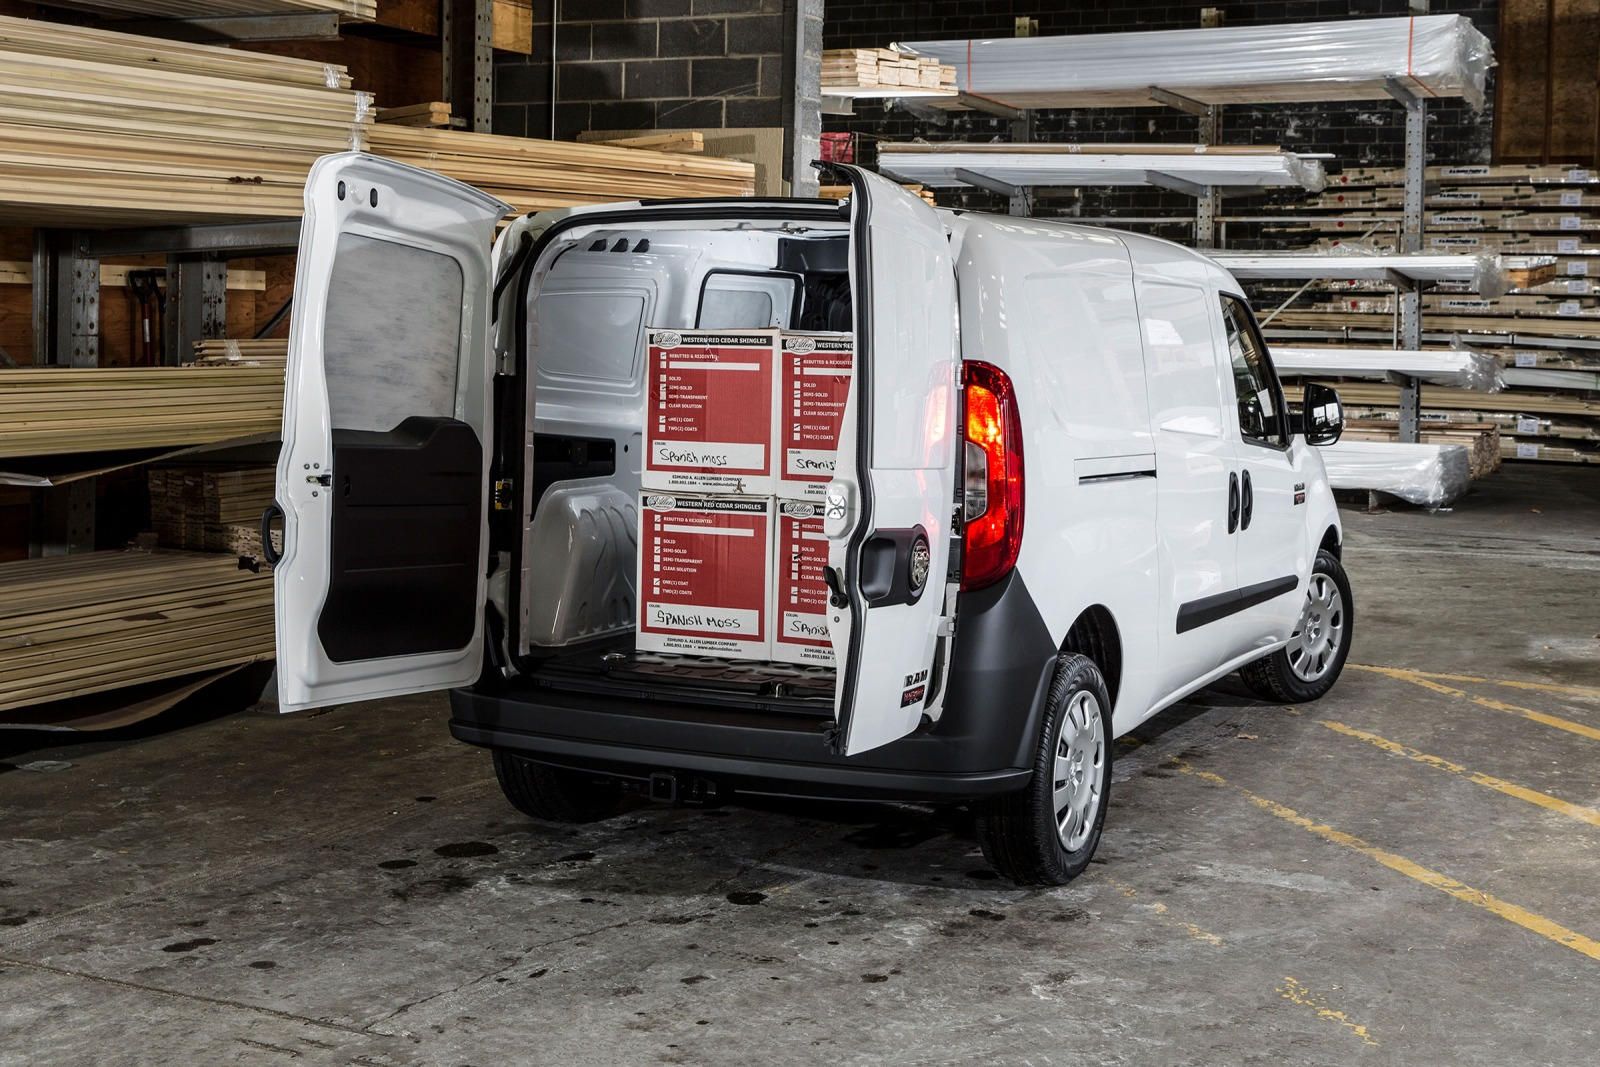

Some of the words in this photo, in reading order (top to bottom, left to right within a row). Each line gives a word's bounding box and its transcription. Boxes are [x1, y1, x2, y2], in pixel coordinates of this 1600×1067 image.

[796, 458, 836, 470] Spanis
[706, 616, 740, 628] MOSS
[904, 670, 928, 686] RAM
